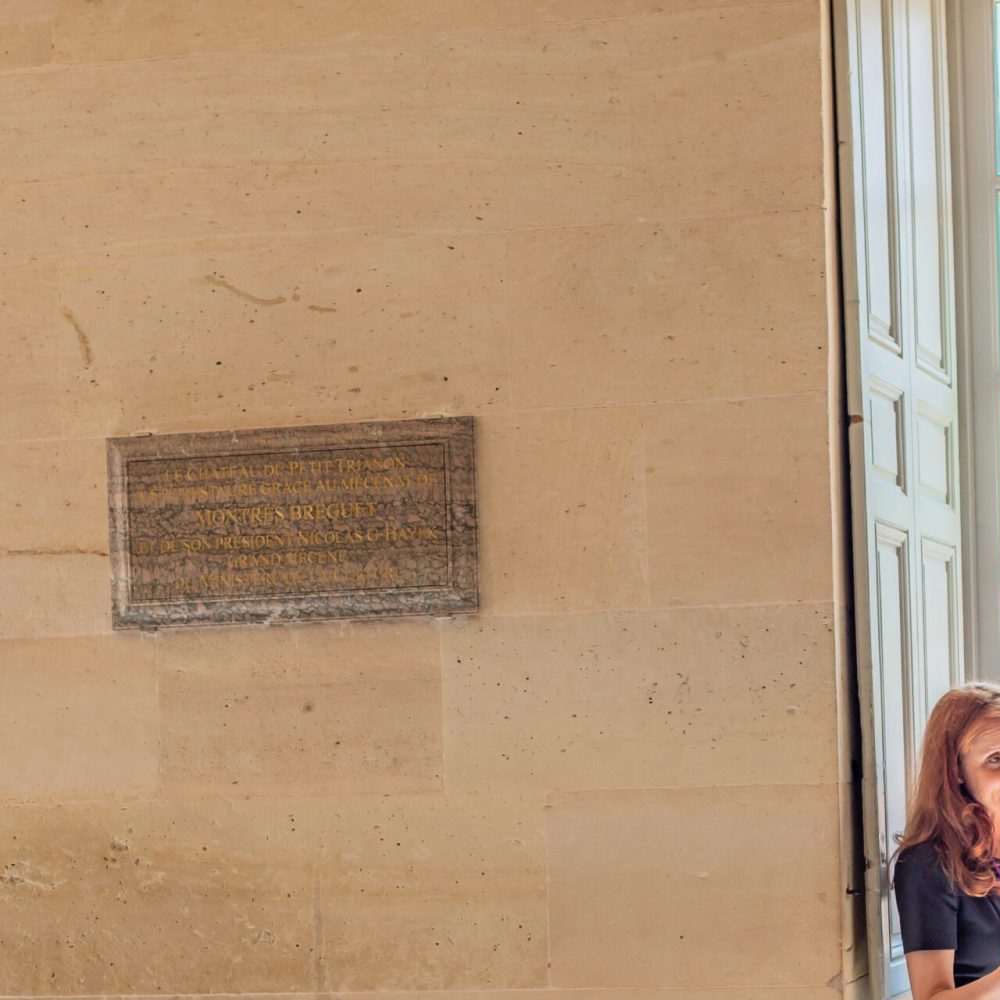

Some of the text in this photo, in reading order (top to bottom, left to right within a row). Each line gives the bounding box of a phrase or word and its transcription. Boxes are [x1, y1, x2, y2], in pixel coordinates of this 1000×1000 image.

[162, 467, 182, 482] LE
[263, 464, 280, 477] DE
[287, 460, 331, 475] PETIT
[335, 456, 405, 473] TRIANON
[315, 479, 336, 494] AU
[415, 473, 435, 486] DE
[194, 501, 376, 527] MONTRES BREGUET
[160, 539, 178, 553] DE
[183, 537, 211, 552] SON
[298, 530, 363, 546] NICOLAS
[385, 526, 437, 543] HAYEK
[228, 553, 281, 568] GRAND
